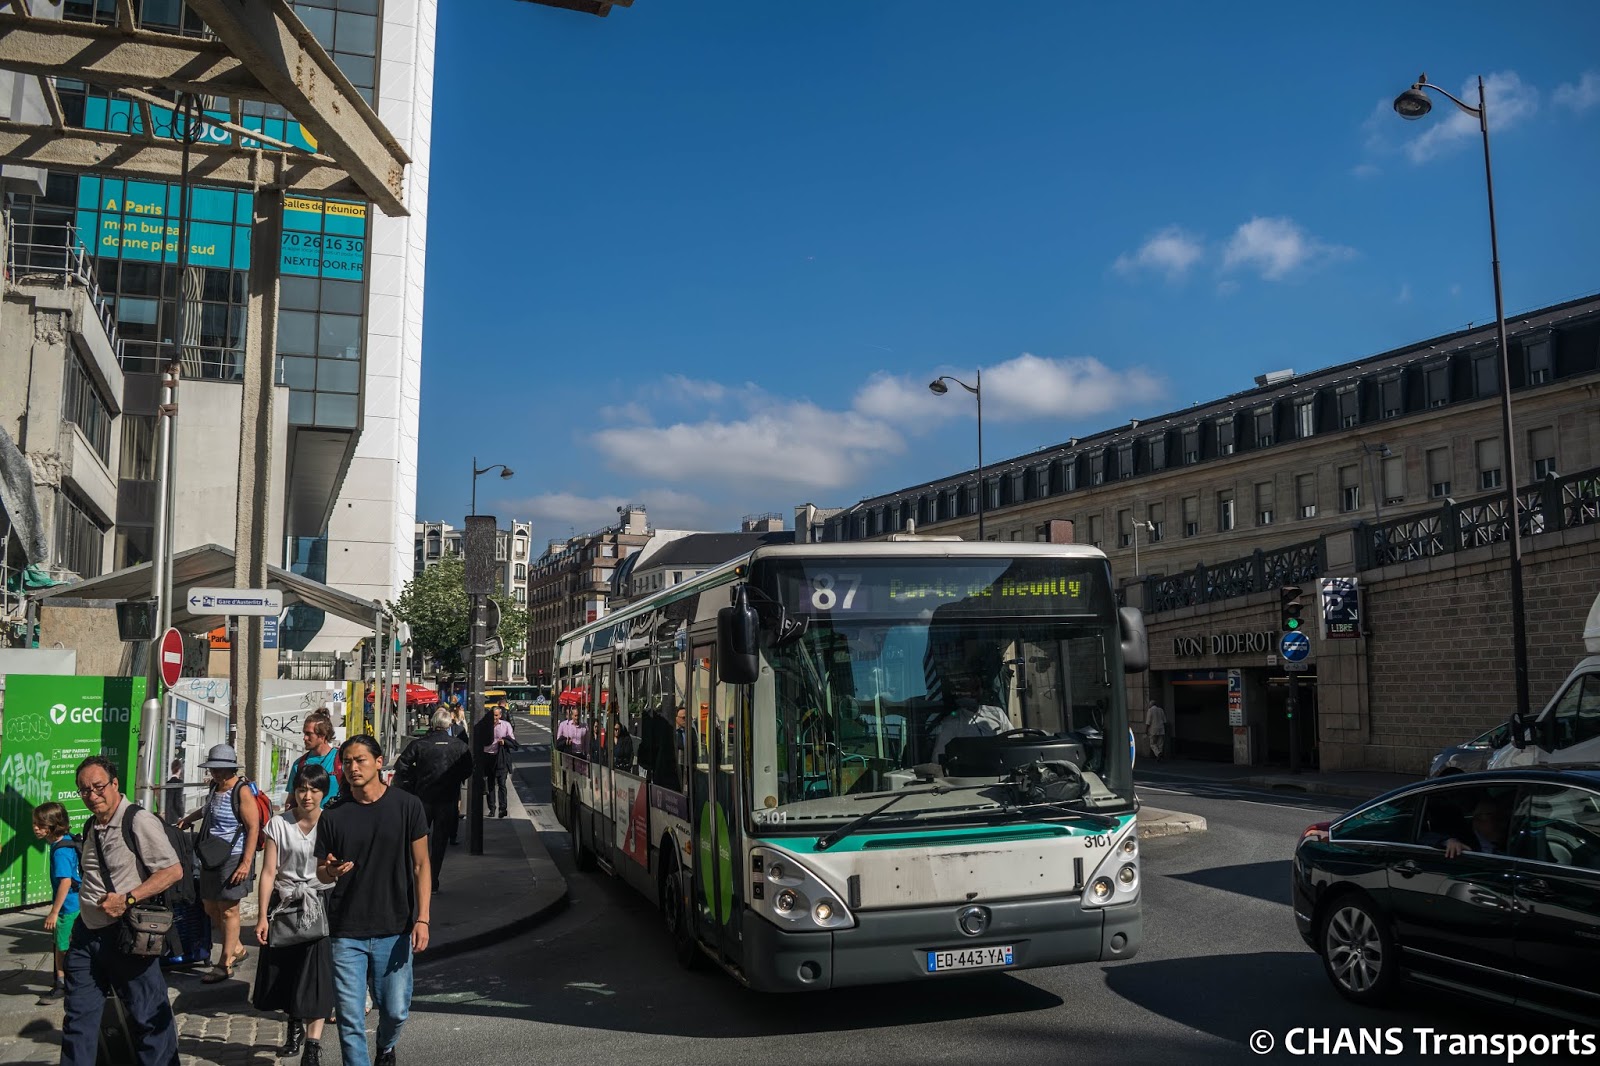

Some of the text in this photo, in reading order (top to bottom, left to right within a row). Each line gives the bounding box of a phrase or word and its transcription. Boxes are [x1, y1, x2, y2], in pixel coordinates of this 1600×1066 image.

[106, 199, 162, 215] A Paris
[283, 199, 310, 209] Salles
[327, 204, 365, 216] réunion
[141, 222, 187, 237] burea
[102, 235, 215, 255] donne plei sud
[282, 234, 300, 246] 70
[303, 235, 321, 248] 26
[326, 238, 342, 251] 16
[346, 240, 363, 253] 30
[283, 256, 363, 272] NEXTDOOR.FR
[811, 573, 861, 610] 87
[967, 578, 993, 597] de
[1331, 623, 1353, 632] LIBRE
[1172, 631, 1274, 656] LYON DIDEROT
[756, 810, 787, 825] 3101
[1084, 834, 1112, 849] 3101
